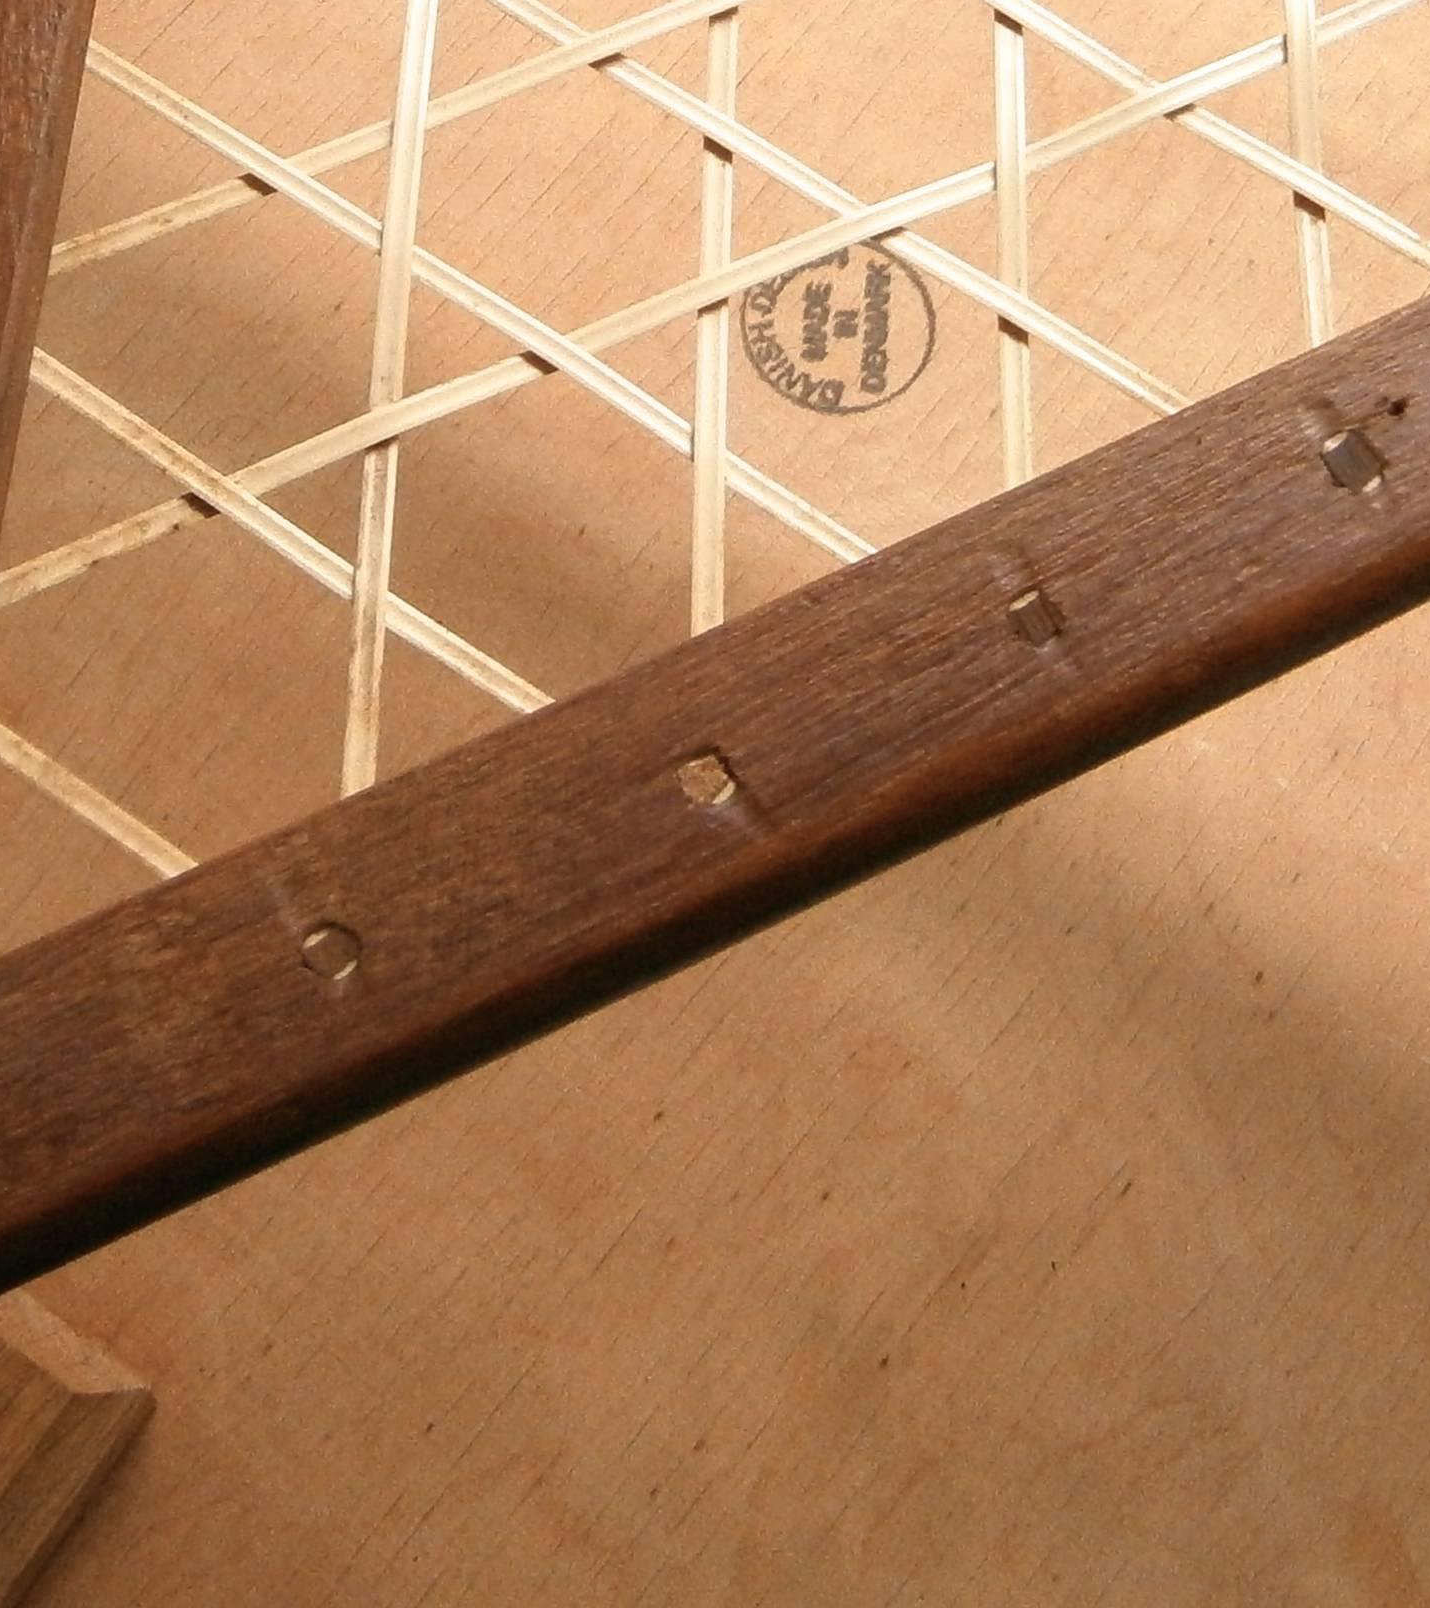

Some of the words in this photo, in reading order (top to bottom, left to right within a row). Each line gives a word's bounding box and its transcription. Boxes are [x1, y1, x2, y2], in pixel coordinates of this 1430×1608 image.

[748, 319, 845, 407] DANISH
[800, 280, 832, 362] MADE
[833, 309, 859, 339] IN
[860, 259, 892, 394] DENMARK
